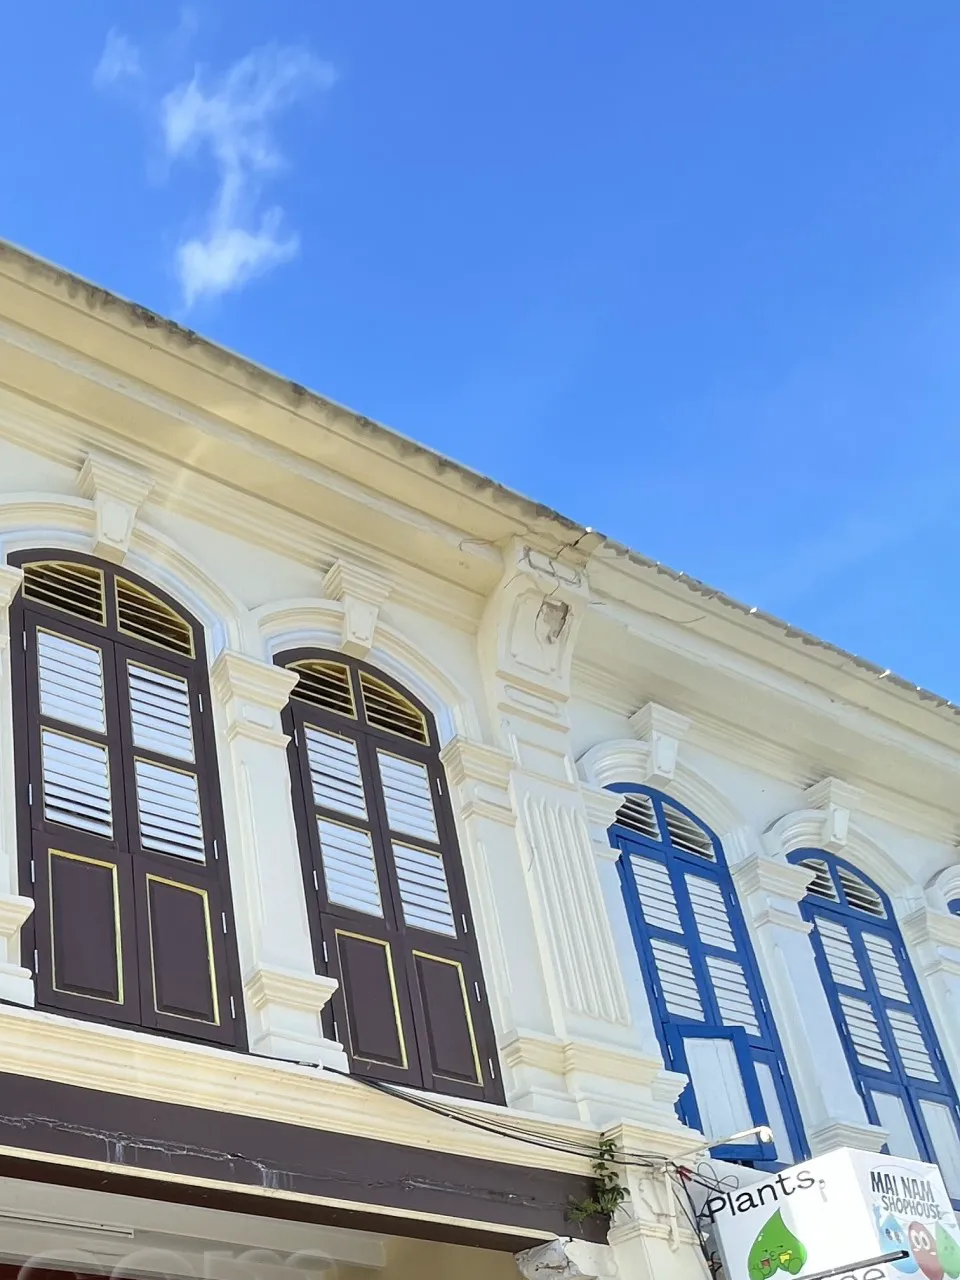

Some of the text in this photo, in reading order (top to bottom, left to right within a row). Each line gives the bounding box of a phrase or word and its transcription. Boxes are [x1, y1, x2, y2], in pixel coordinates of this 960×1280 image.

[870, 1171, 935, 1203] MAI NAM
[881, 1195, 942, 1220] SHOPHOUSE
